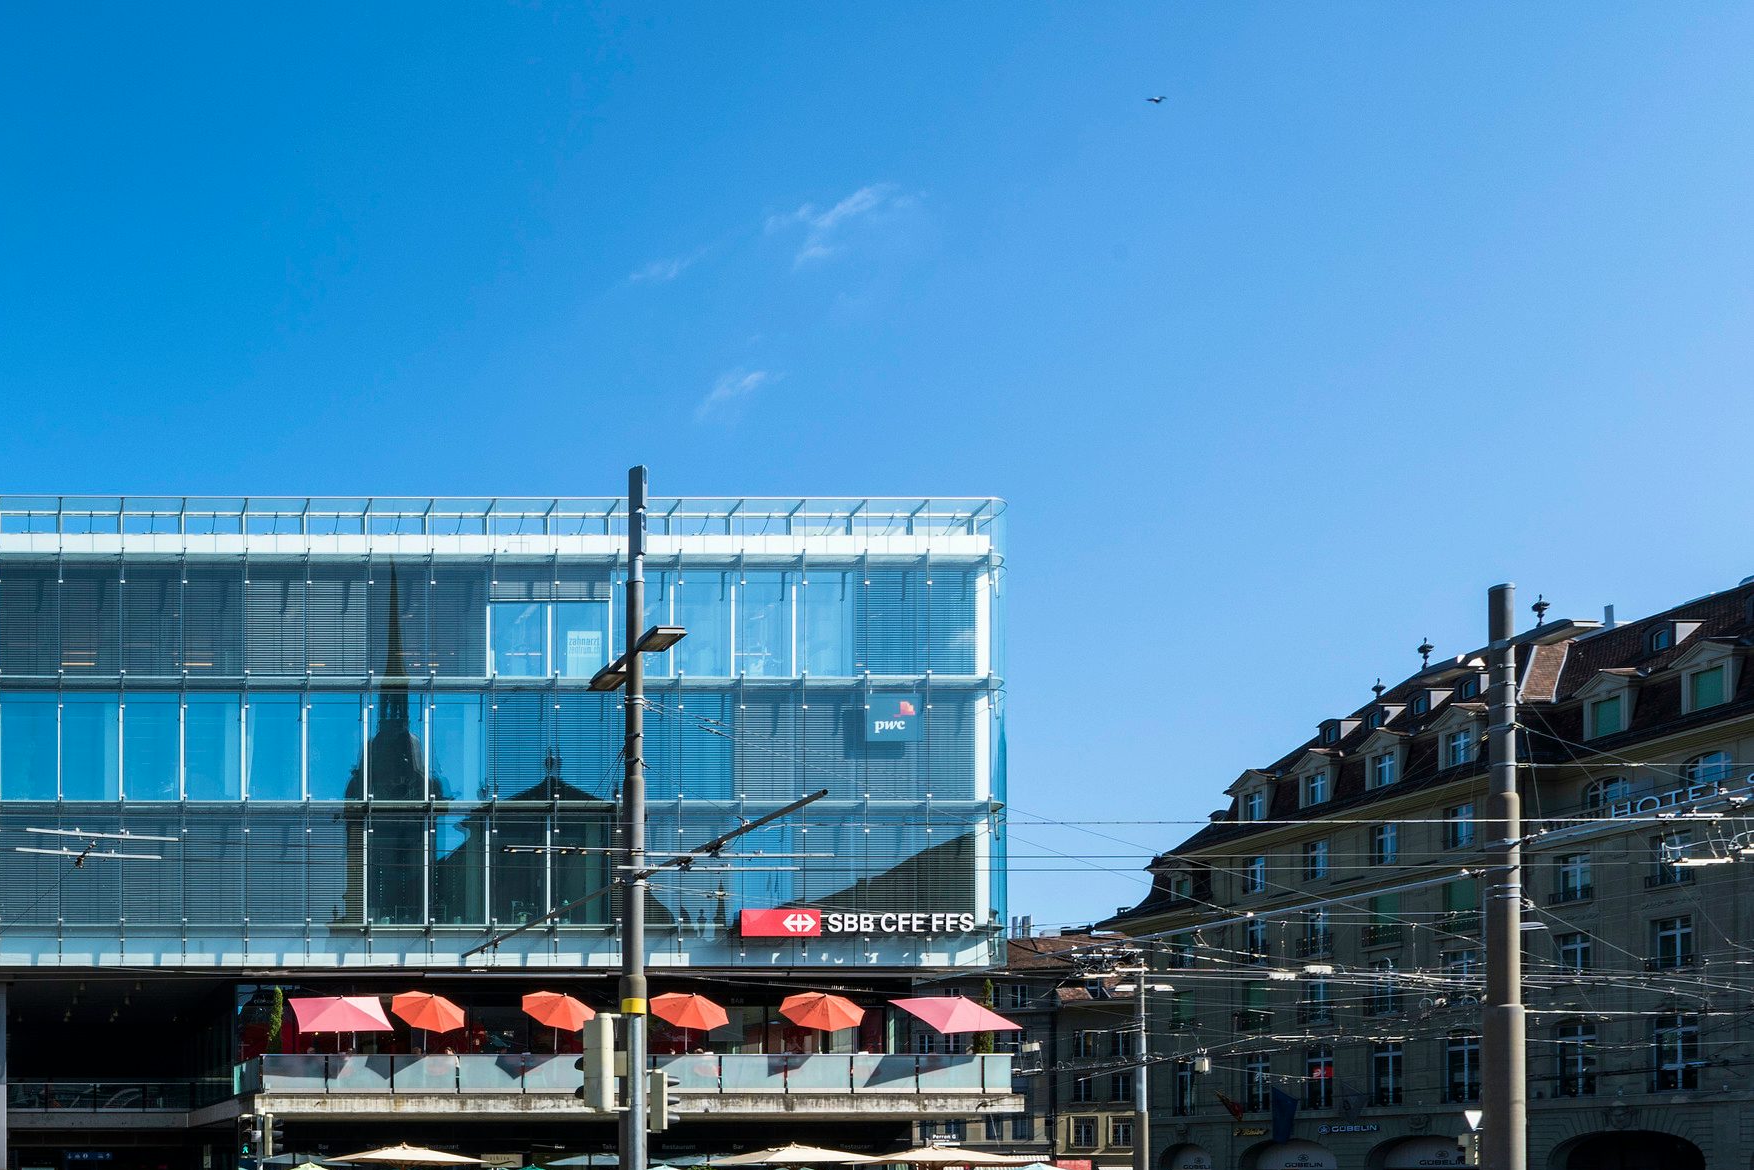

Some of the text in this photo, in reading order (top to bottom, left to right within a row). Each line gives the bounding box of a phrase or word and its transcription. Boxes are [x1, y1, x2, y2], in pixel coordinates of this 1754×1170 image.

[569, 636, 600, 646] zahnarzt
[874, 720, 906, 734] pwc
[827, 913, 875, 932] SBB
[931, 913, 975, 932] FFS
